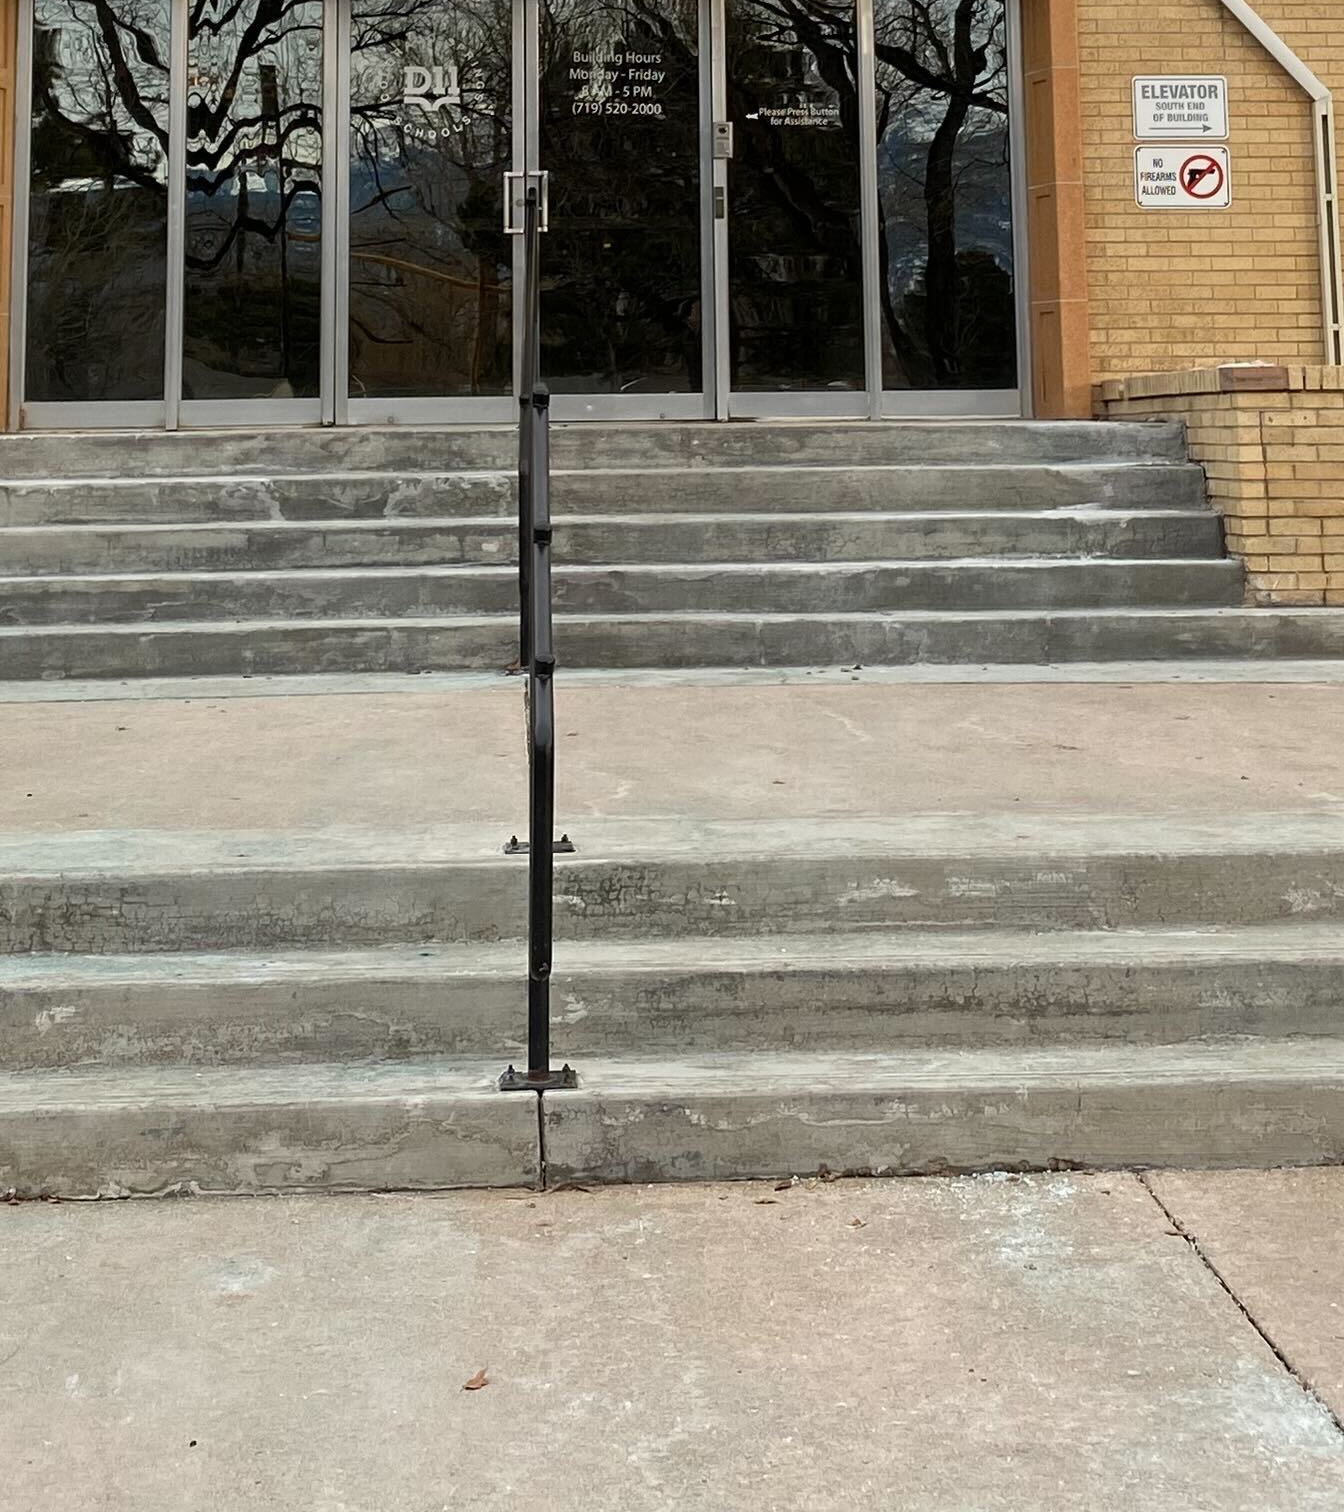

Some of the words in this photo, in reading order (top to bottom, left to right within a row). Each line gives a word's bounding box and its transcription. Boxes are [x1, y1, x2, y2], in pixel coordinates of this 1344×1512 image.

[573, 51, 623, 66] Building
[626, 51, 662, 64] Hours
[404, 66, 460, 95] D11
[569, 68, 618, 82] Monday
[628, 69, 665, 83] Friday
[623, 86, 630, 97] 5
[633, 86, 653, 97] PM
[1141, 85, 1218, 99] ELEVATOR
[572, 102, 602, 116] (719)
[605, 103, 662, 115] 520-2000
[758, 108, 787, 116] Please
[787, 108, 808, 116] Press
[810, 108, 839, 116] Button
[1155, 102, 1185, 111] SOUTH
[1187, 102, 1205, 110] END
[770, 117, 782, 125] for
[784, 117, 828, 125] Assistance
[1153, 114, 1164, 122] OF
[1167, 113, 1208, 122] BUILDING
[394, 116, 471, 139] SCHOOLS
[1152, 158, 1163, 168] NO
[1140, 171, 1177, 182] FIREARMS
[1141, 185, 1176, 196] ALLOWED
